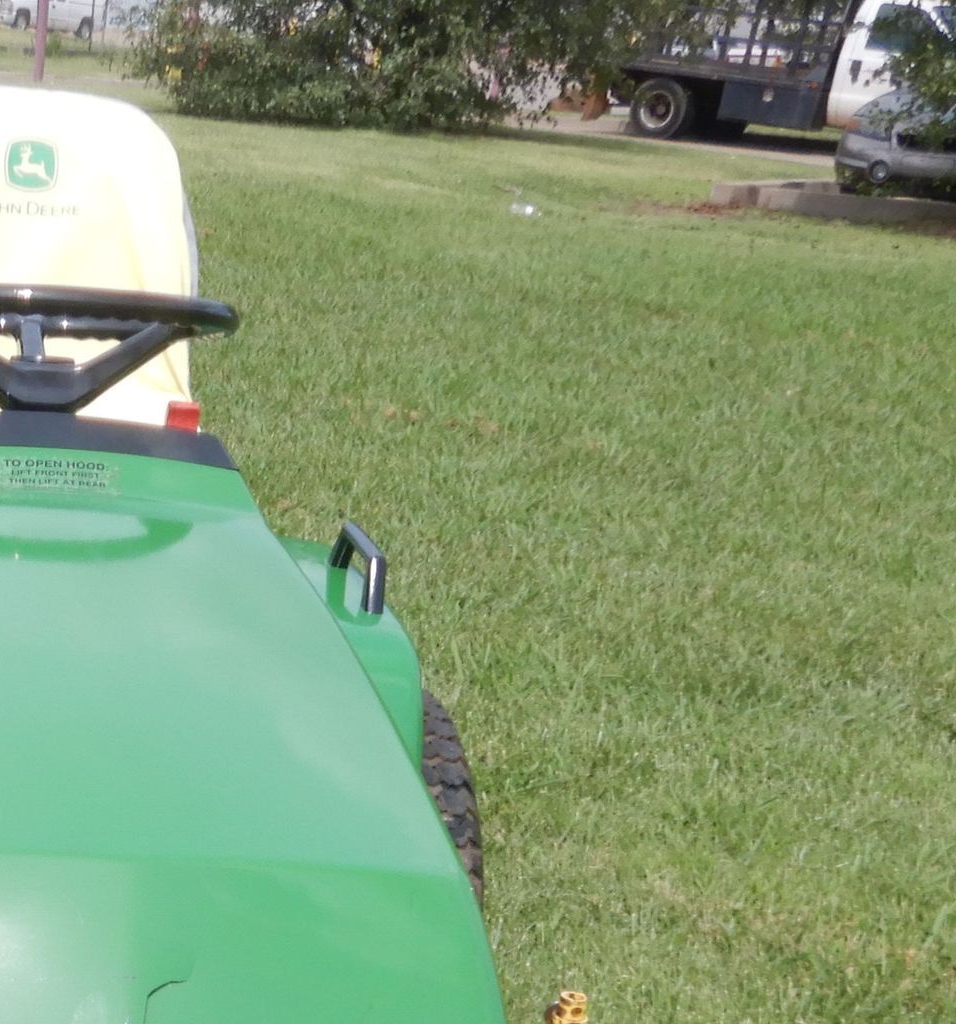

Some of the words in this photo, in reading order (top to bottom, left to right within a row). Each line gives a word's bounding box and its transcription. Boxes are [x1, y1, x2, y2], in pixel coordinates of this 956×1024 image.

[4, 459, 21, 467] TO
[25, 459, 62, 468] OPEN
[72, 471, 99, 479] FIRST
